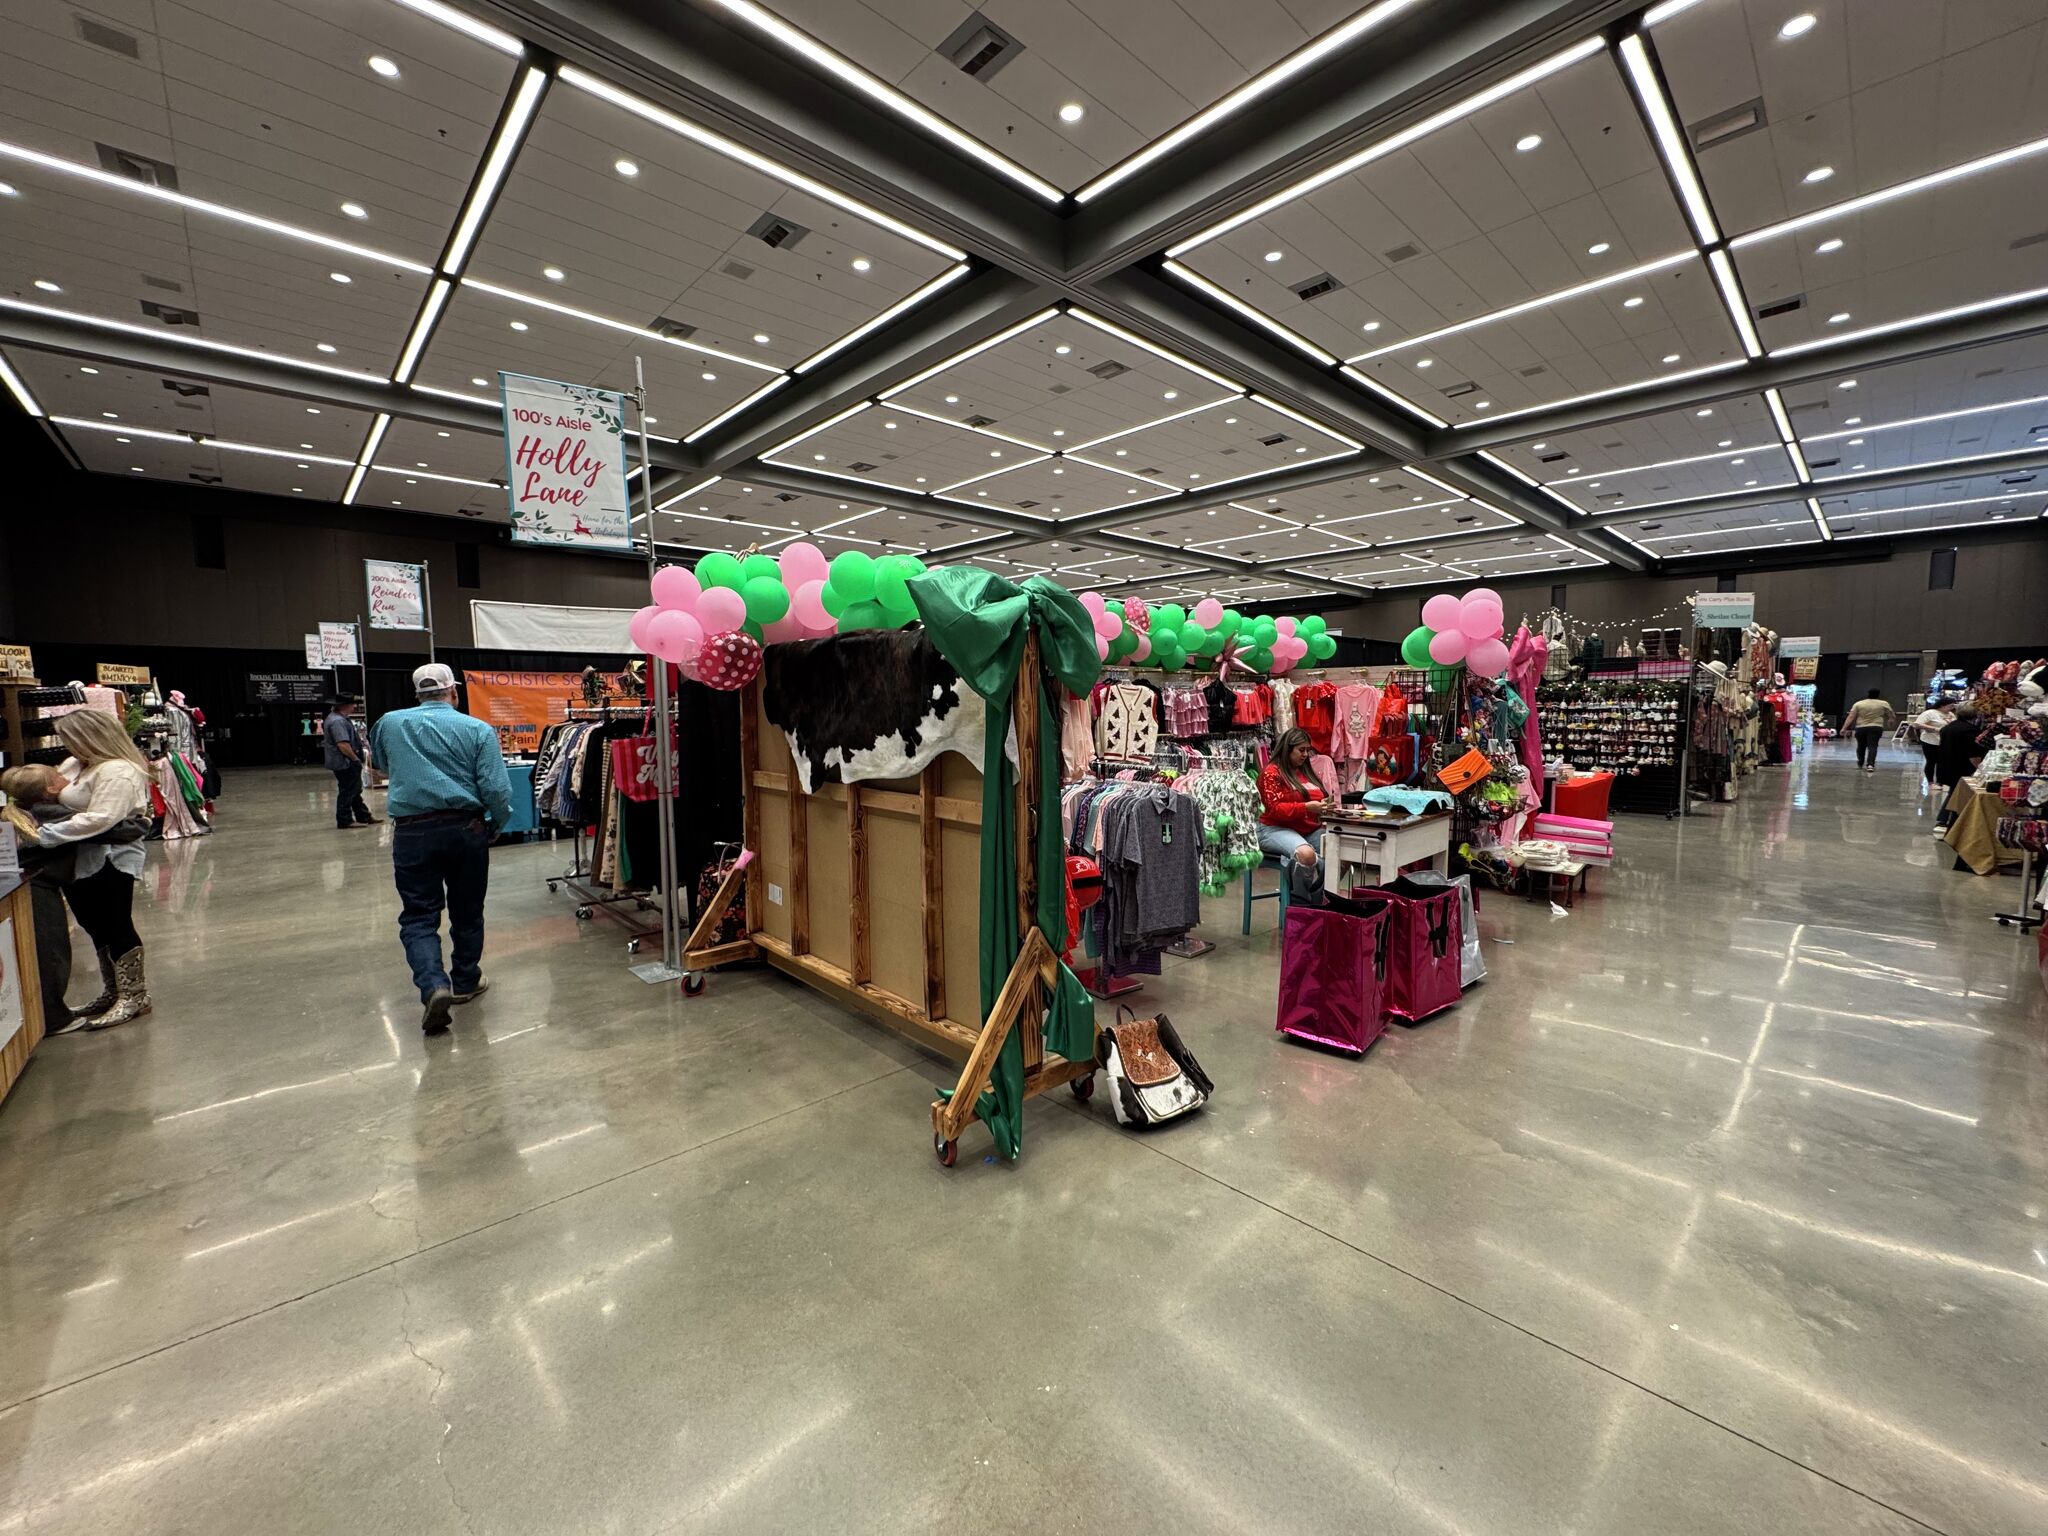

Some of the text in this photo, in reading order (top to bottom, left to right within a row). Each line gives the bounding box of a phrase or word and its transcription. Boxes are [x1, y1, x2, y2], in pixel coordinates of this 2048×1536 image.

[512, 408, 592, 432] 100's Aisle
[516, 435, 607, 488] Holly
[520, 471, 588, 507] Lane
[583, 514, 624, 525] Home for the
[371, 575, 390, 583] 200's
[371, 584, 417, 600] Reindeer
[372, 599, 396, 614] Run
[102, 665, 134, 674] BLANKETS
[466, 673, 477, 685] A
[482, 672, 557, 687] HOLISTIC
